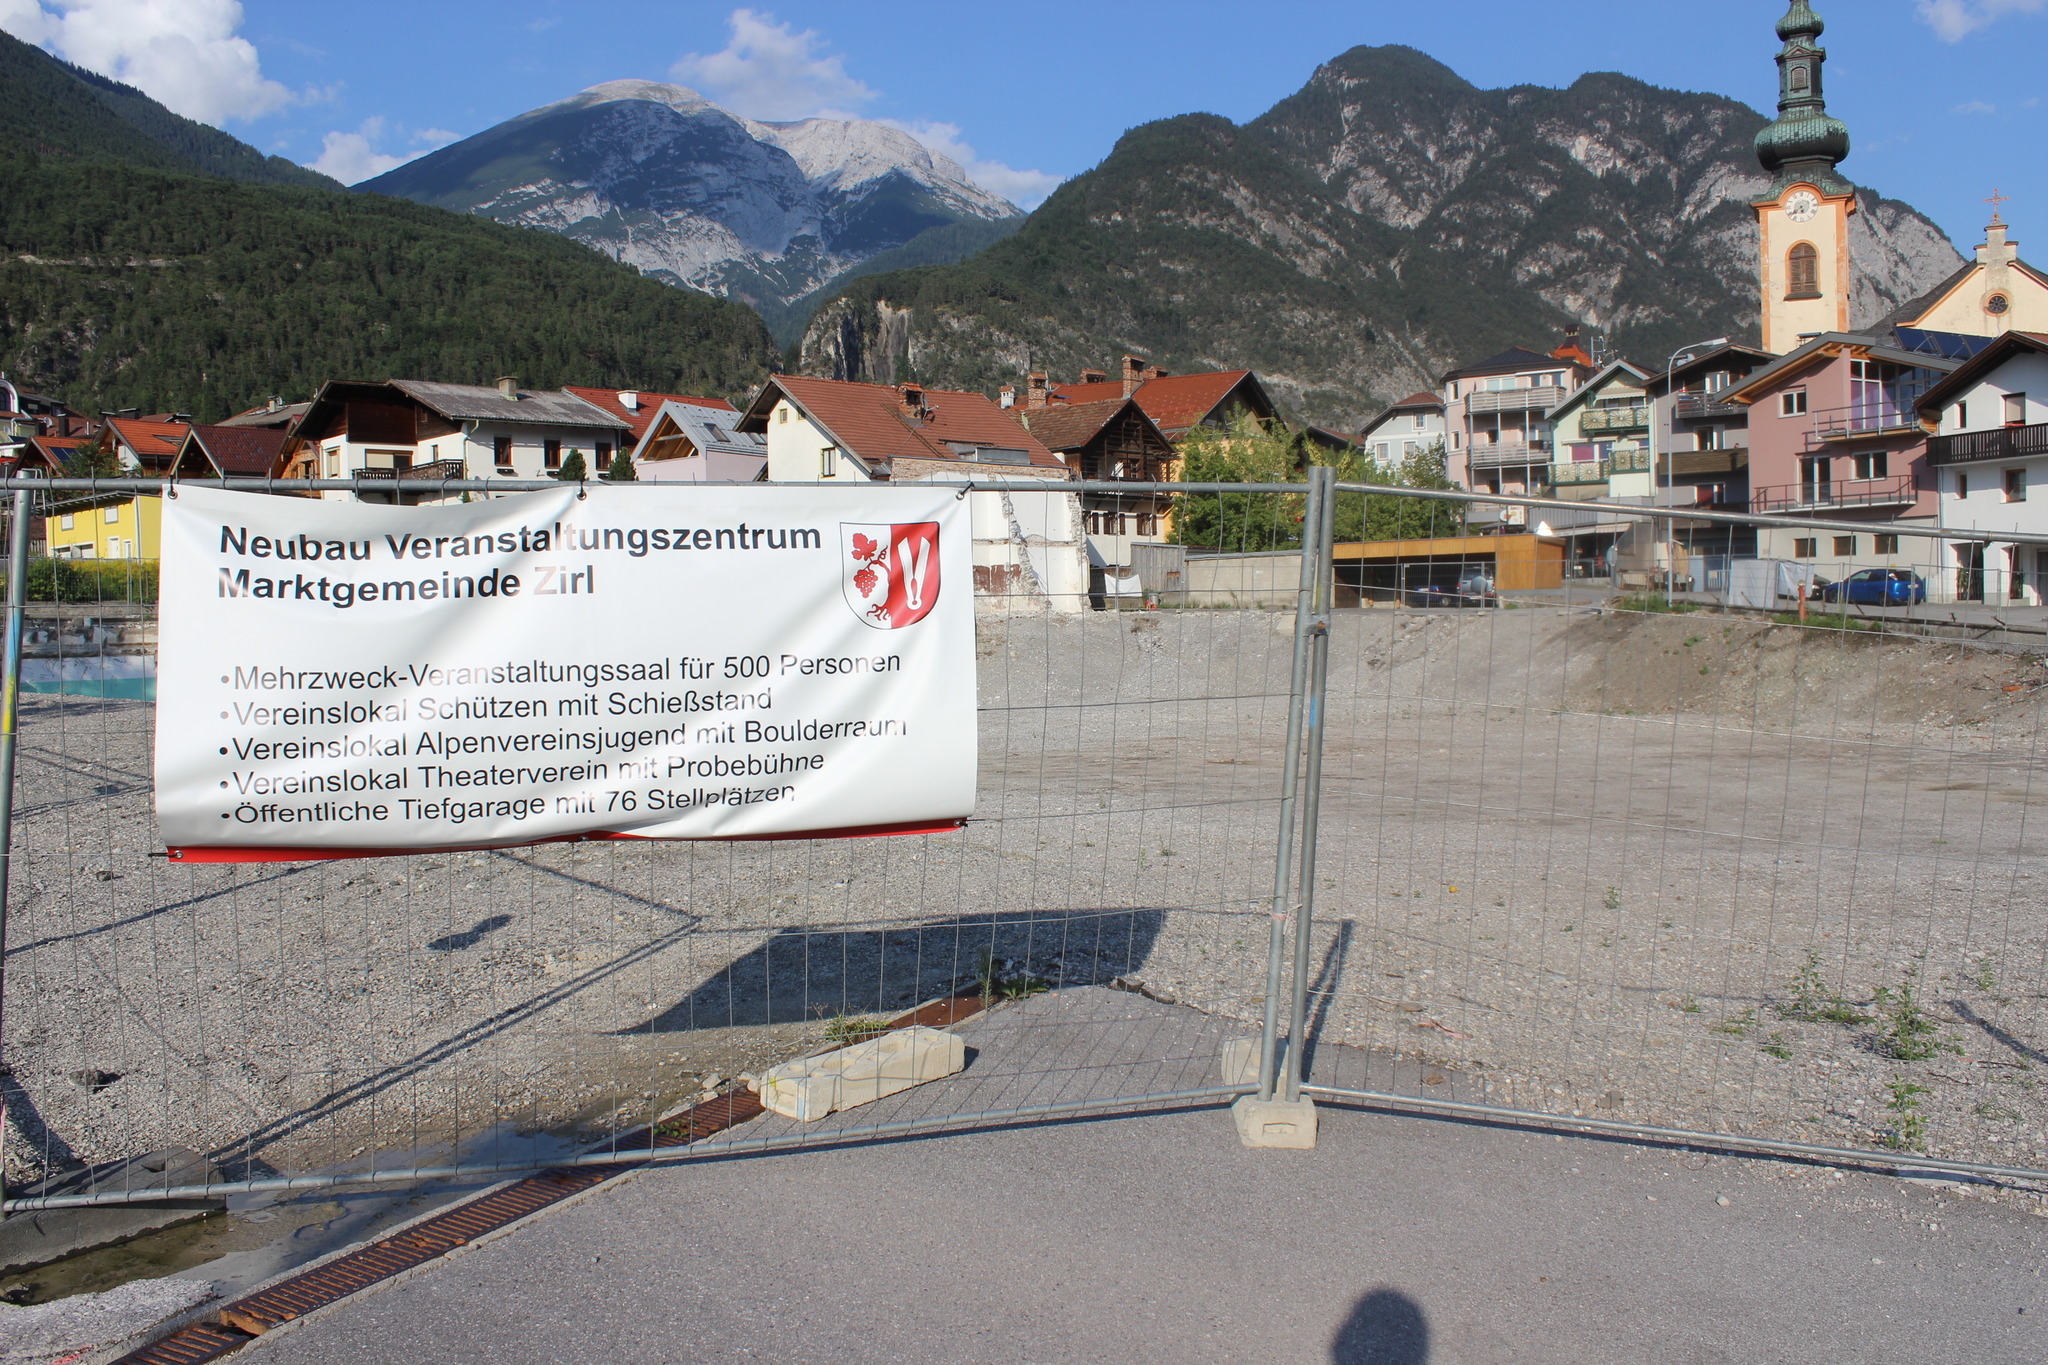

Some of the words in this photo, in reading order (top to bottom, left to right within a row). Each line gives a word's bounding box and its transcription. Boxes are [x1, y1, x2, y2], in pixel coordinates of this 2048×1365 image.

[220, 525, 371, 560] Neubau
[384, 522, 821, 560] Veranstaltungszentrum
[218, 567, 520, 608] Marktgemeinde
[533, 564, 594, 596] Zirl
[679, 657, 715, 680] für
[723, 655, 770, 679] 500
[780, 652, 901, 676] Personen
[418, 695, 547, 722] Schützen
[558, 698, 598, 717] mit
[607, 688, 772, 716] Schießstand
[416, 724, 686, 760] Alpenvereinsjugend
[695, 724, 736, 744] mit
[744, 717, 907, 743] Boulderraum
[418, 761, 608, 788] Theaterverein
[618, 760, 657, 780] mit
[667, 750, 824, 778] Probebühne
[399, 796, 546, 824] Tiefgarage
[555, 792, 596, 814] mit
[605, 790, 637, 812] 76
[647, 781, 795, 809] Stellplätzen
